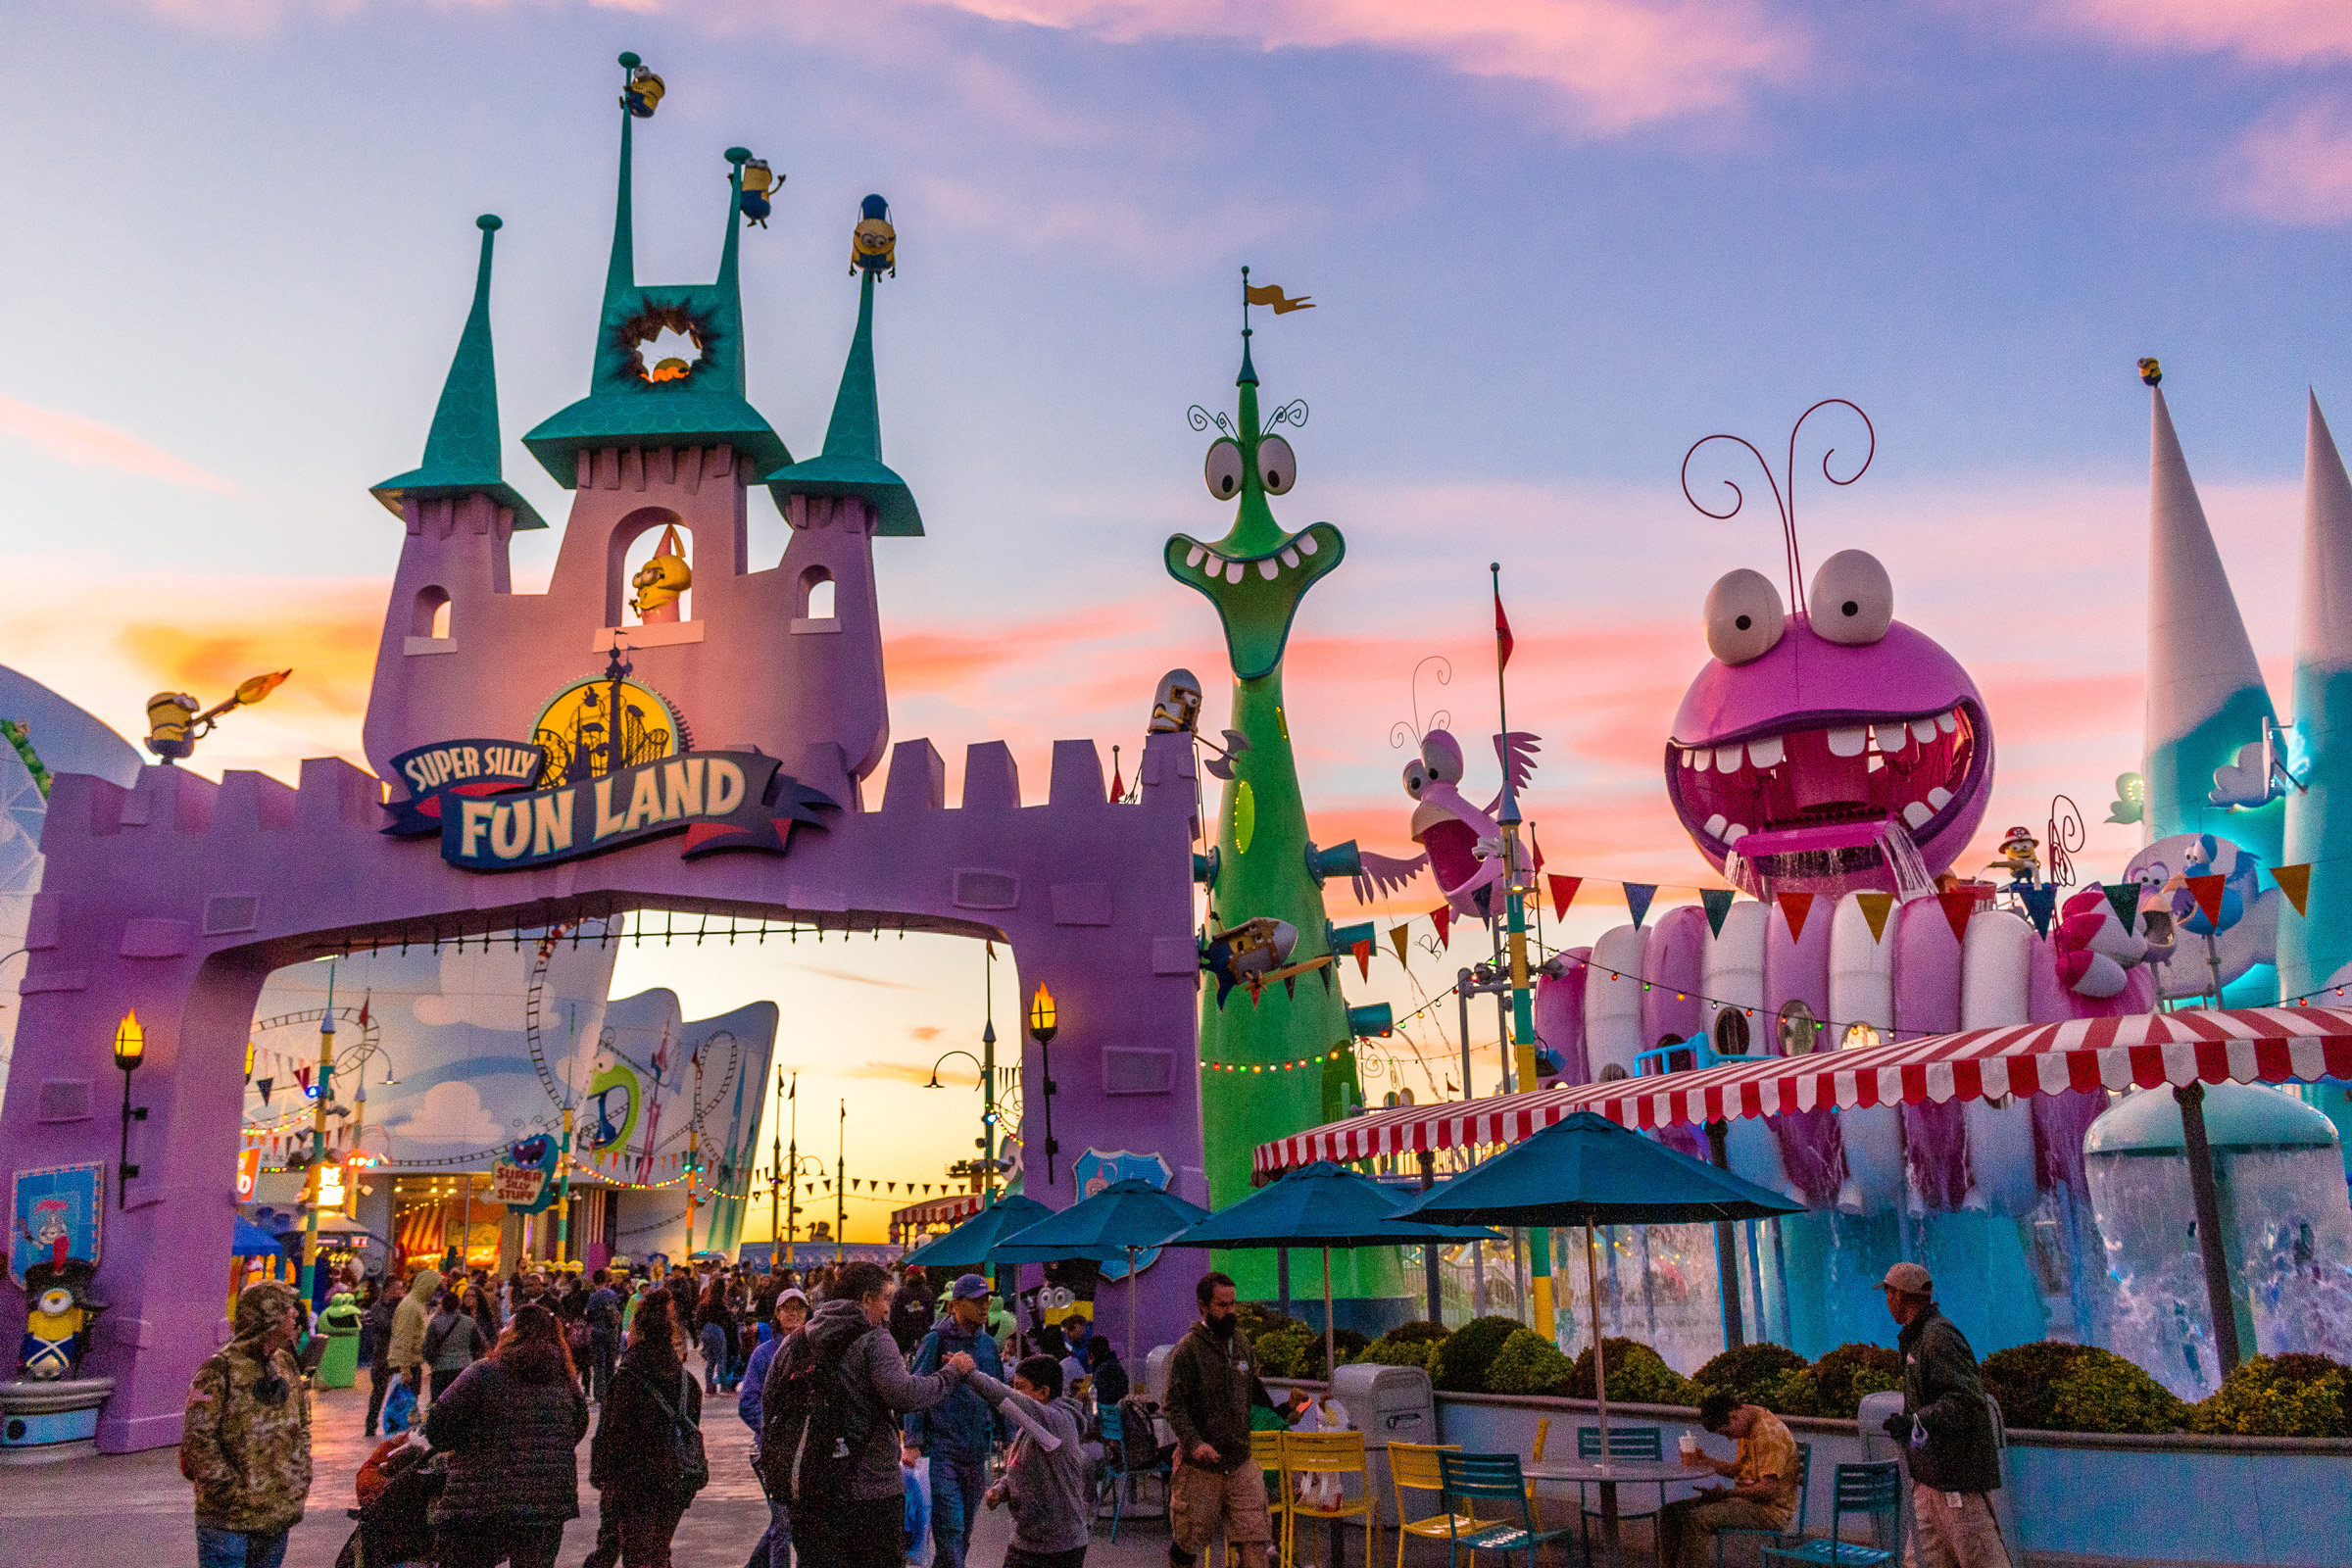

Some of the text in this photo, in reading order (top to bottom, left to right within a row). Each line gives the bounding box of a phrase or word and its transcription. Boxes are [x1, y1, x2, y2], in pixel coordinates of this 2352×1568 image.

[405, 746, 538, 793] SUPER SILLY
[461, 757, 746, 859] FUN LAND
[497, 1167, 542, 1182] SUPER
[497, 1189, 534, 1200] STUFF
